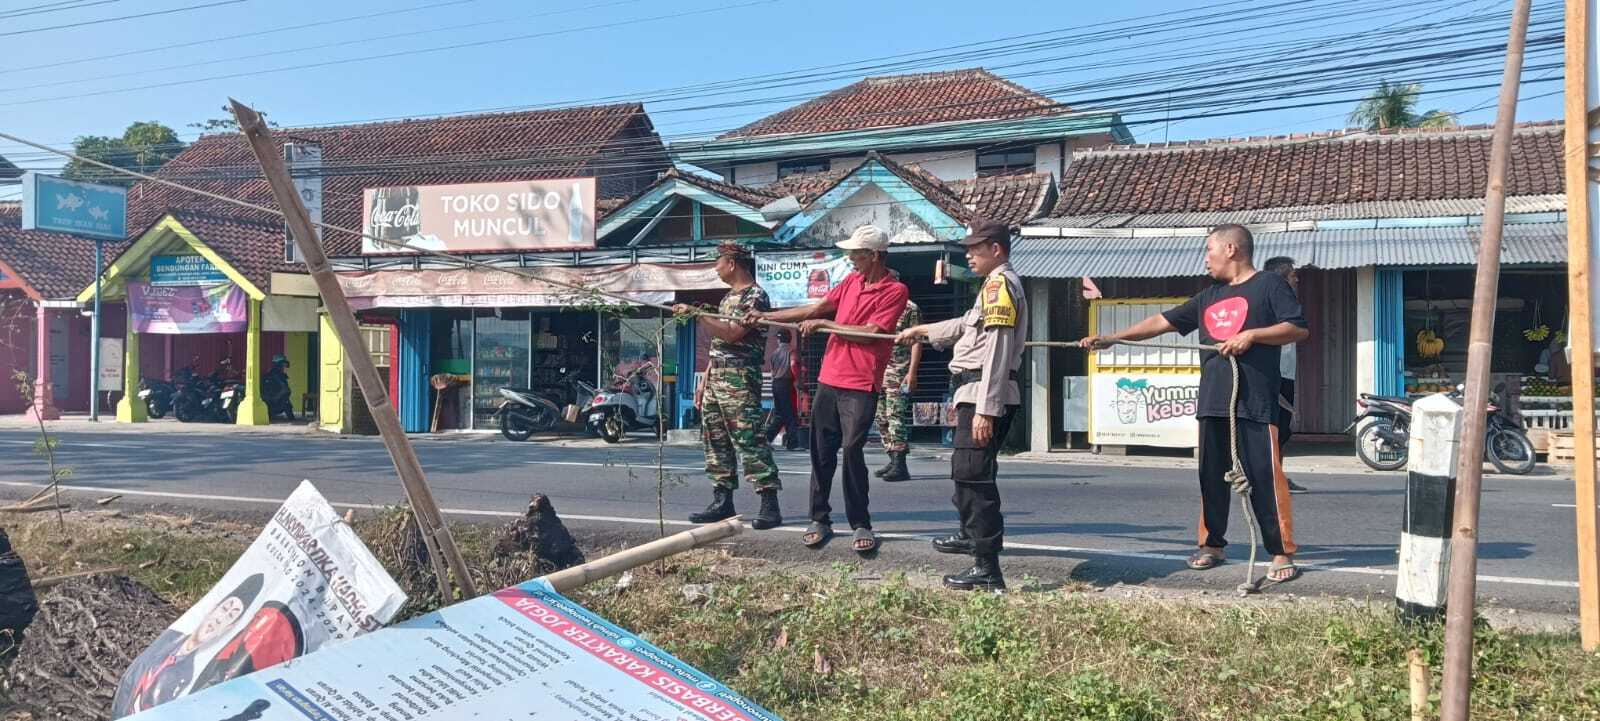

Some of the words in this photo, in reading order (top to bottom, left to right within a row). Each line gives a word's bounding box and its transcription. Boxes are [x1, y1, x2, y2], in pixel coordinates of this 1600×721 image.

[441, 195, 500, 213] TOKO
[507, 191, 561, 210] SIDO
[454, 217, 546, 237] MUNCUL
[757, 263, 777, 272] KINI
[779, 261, 808, 270] CUMA
[1142, 385, 1200, 405] Yumm
[515, 598, 569, 627] JOGJA
[563, 627, 656, 678] KARAKTER
